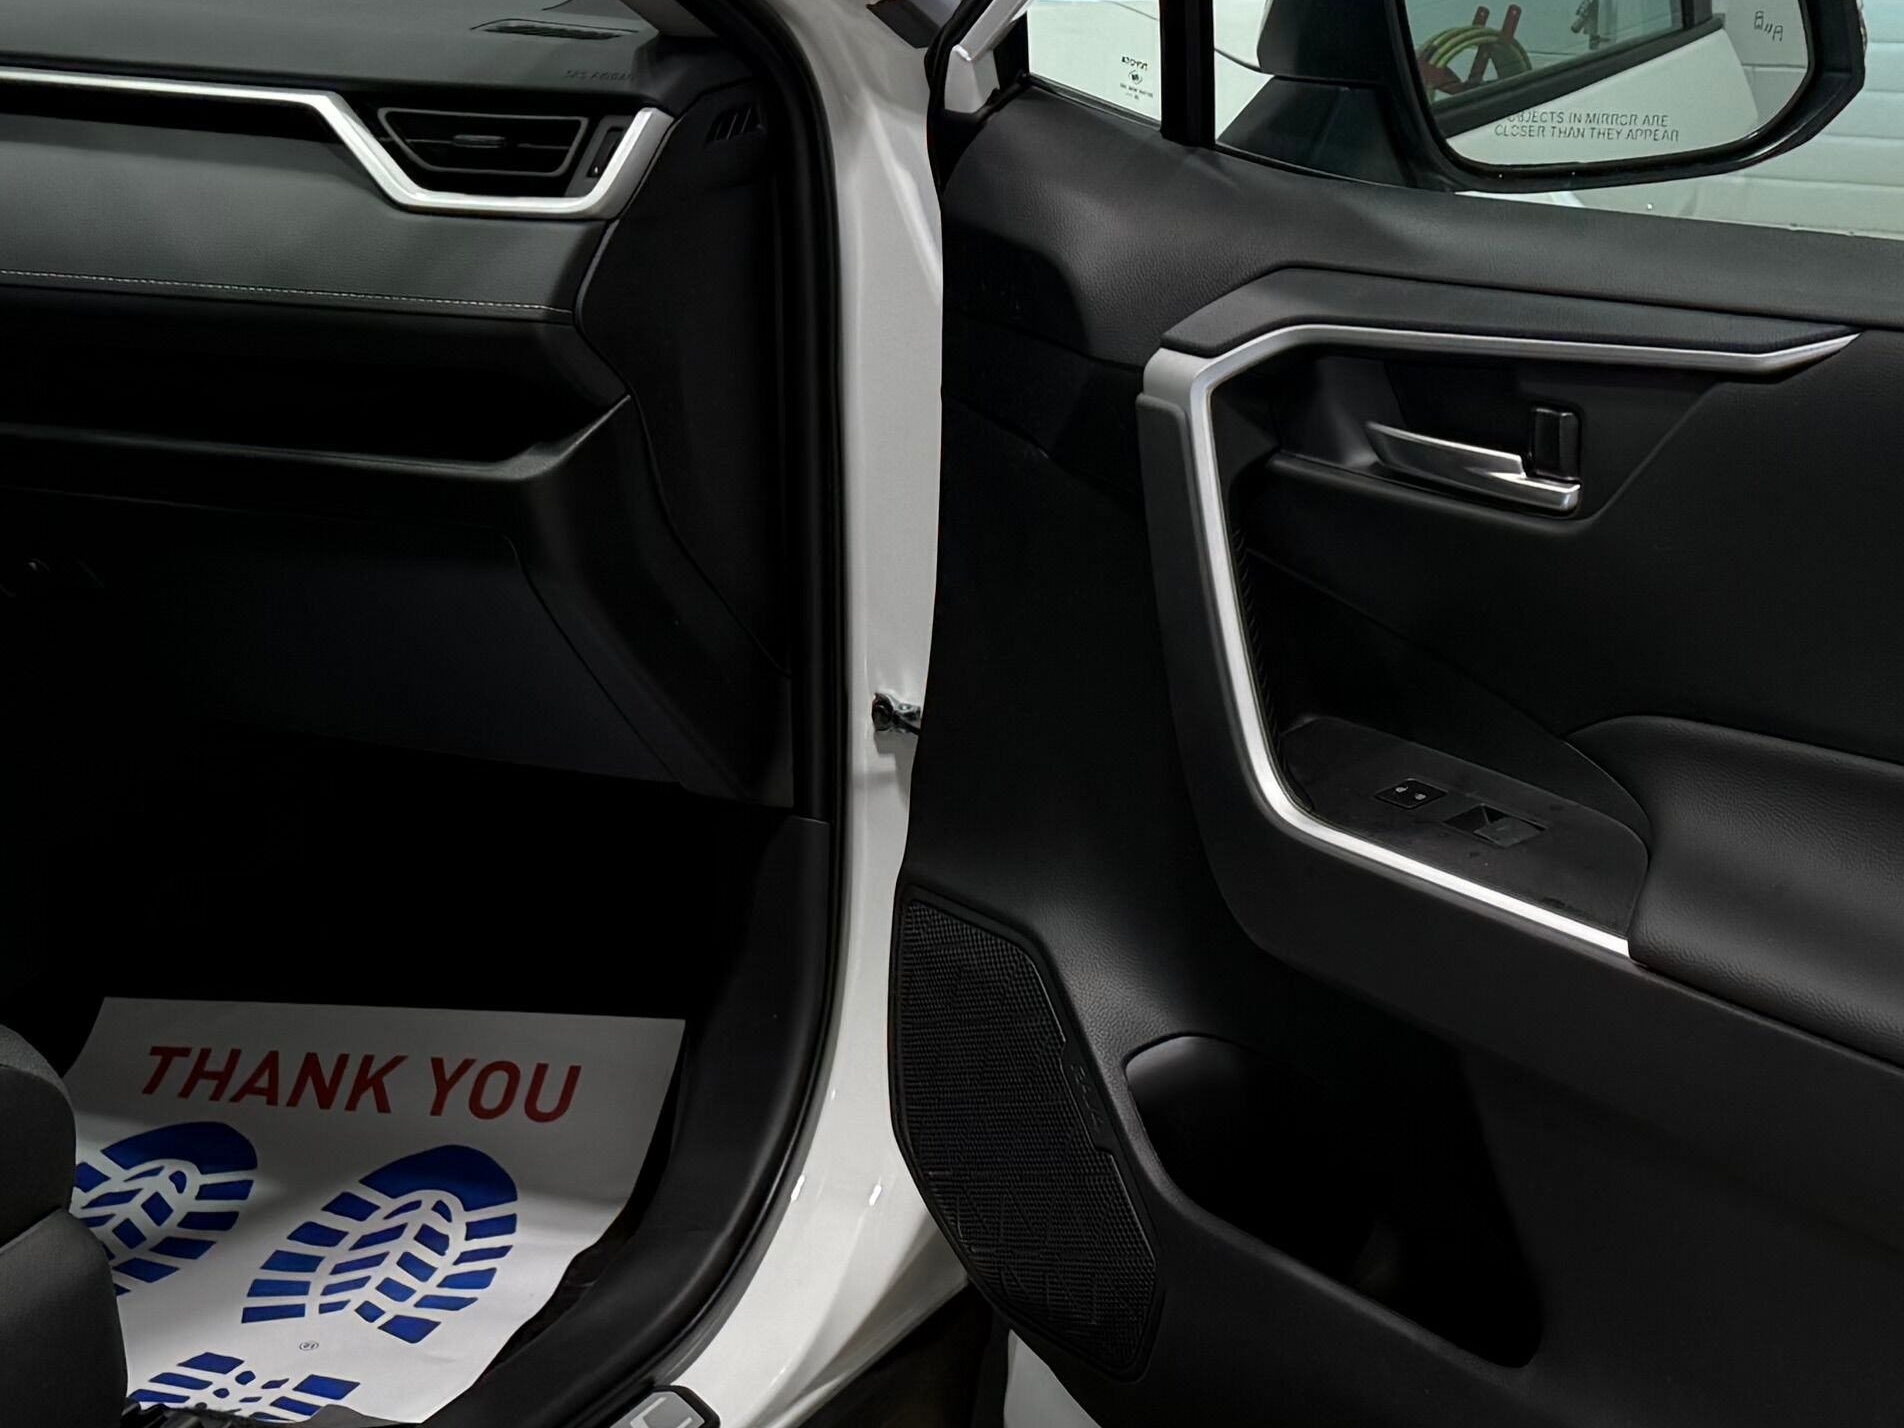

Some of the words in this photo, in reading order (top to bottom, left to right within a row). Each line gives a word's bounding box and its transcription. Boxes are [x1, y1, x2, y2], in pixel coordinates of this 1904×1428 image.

[1569, 112, 1582, 124] IN
[1585, 112, 1638, 126] MIRROR
[1642, 114, 1669, 127] ARE
[1494, 124, 1546, 138] CLOSER
[1550, 125, 1585, 139] THAN
[1589, 127, 1622, 140] THEY
[1626, 128, 1679, 142] APPEAR
[141, 1045, 407, 1115] THANK
[427, 1057, 583, 1123] YOU
